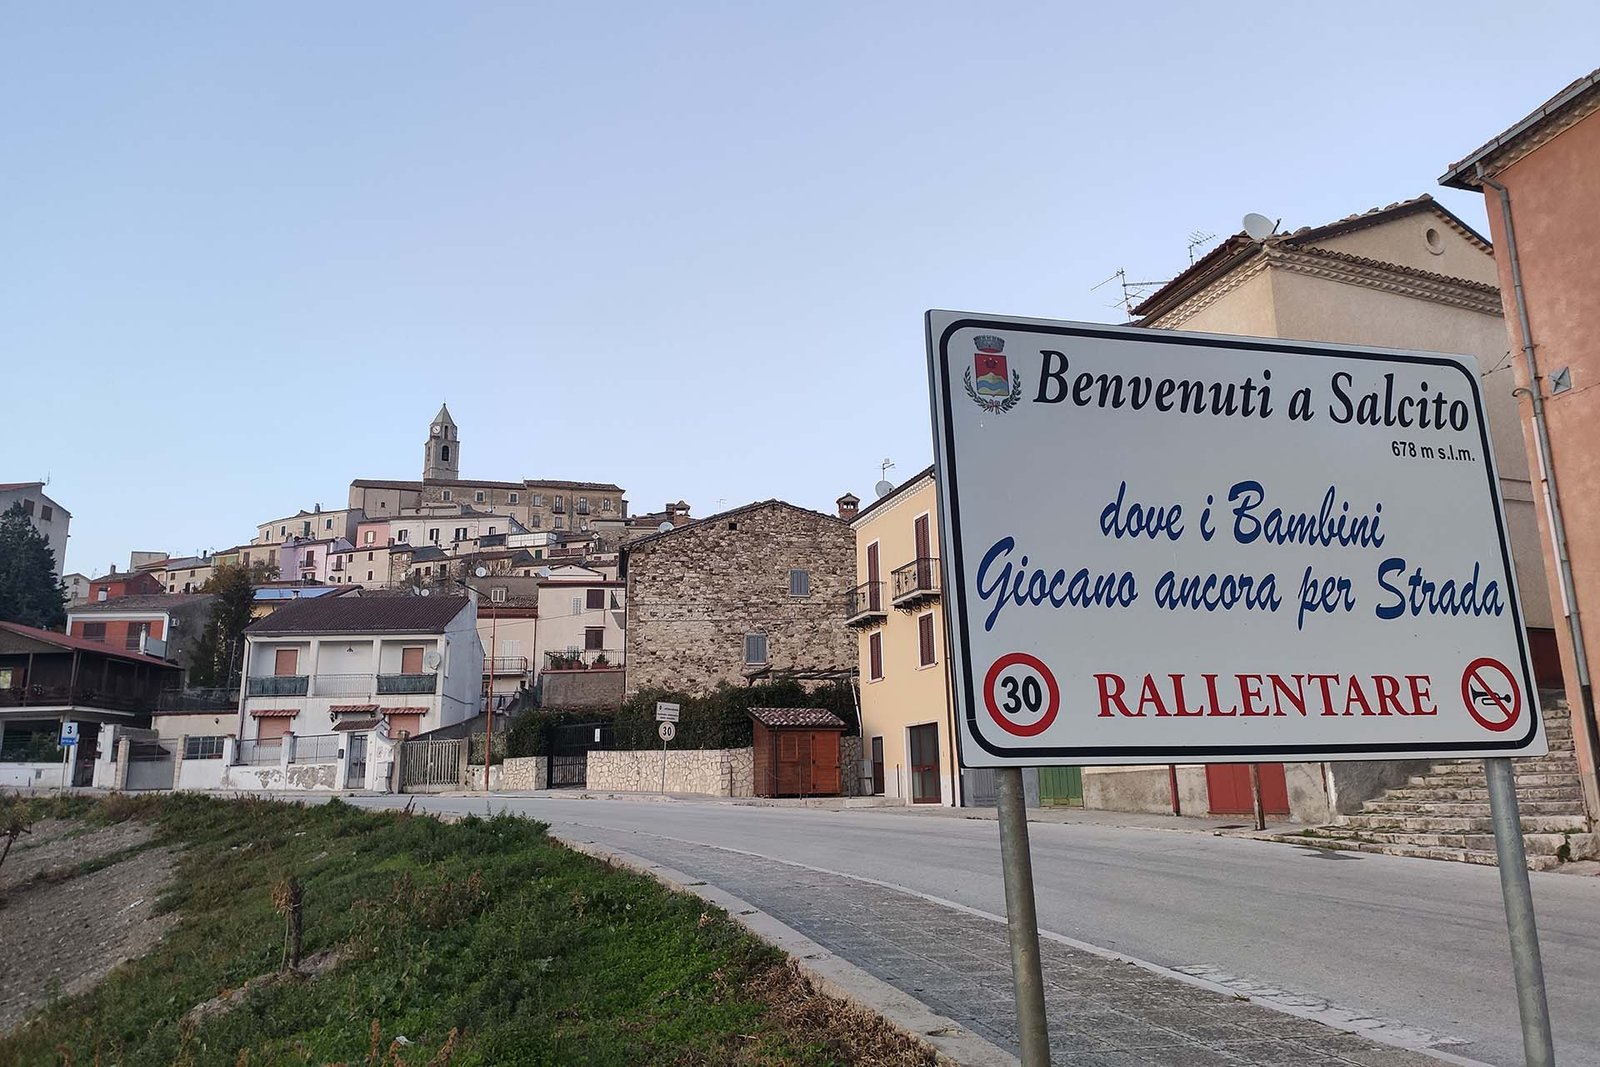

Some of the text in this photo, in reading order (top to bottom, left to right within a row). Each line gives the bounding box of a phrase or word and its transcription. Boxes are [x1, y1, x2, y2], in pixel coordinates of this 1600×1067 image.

[1033, 350, 1470, 432] Benvenuti a Salcito
[1392, 441, 1476, 461] 678 m s.l.m.
[1100, 480, 1385, 548] dove i Bambini
[976, 538, 1504, 631] Giocano ancora per Strada
[1001, 676, 1042, 713] 30
[1093, 674, 1438, 717] RALLENTARE
[67, 726, 72, 734] 3
[663, 726, 672, 736] 30
